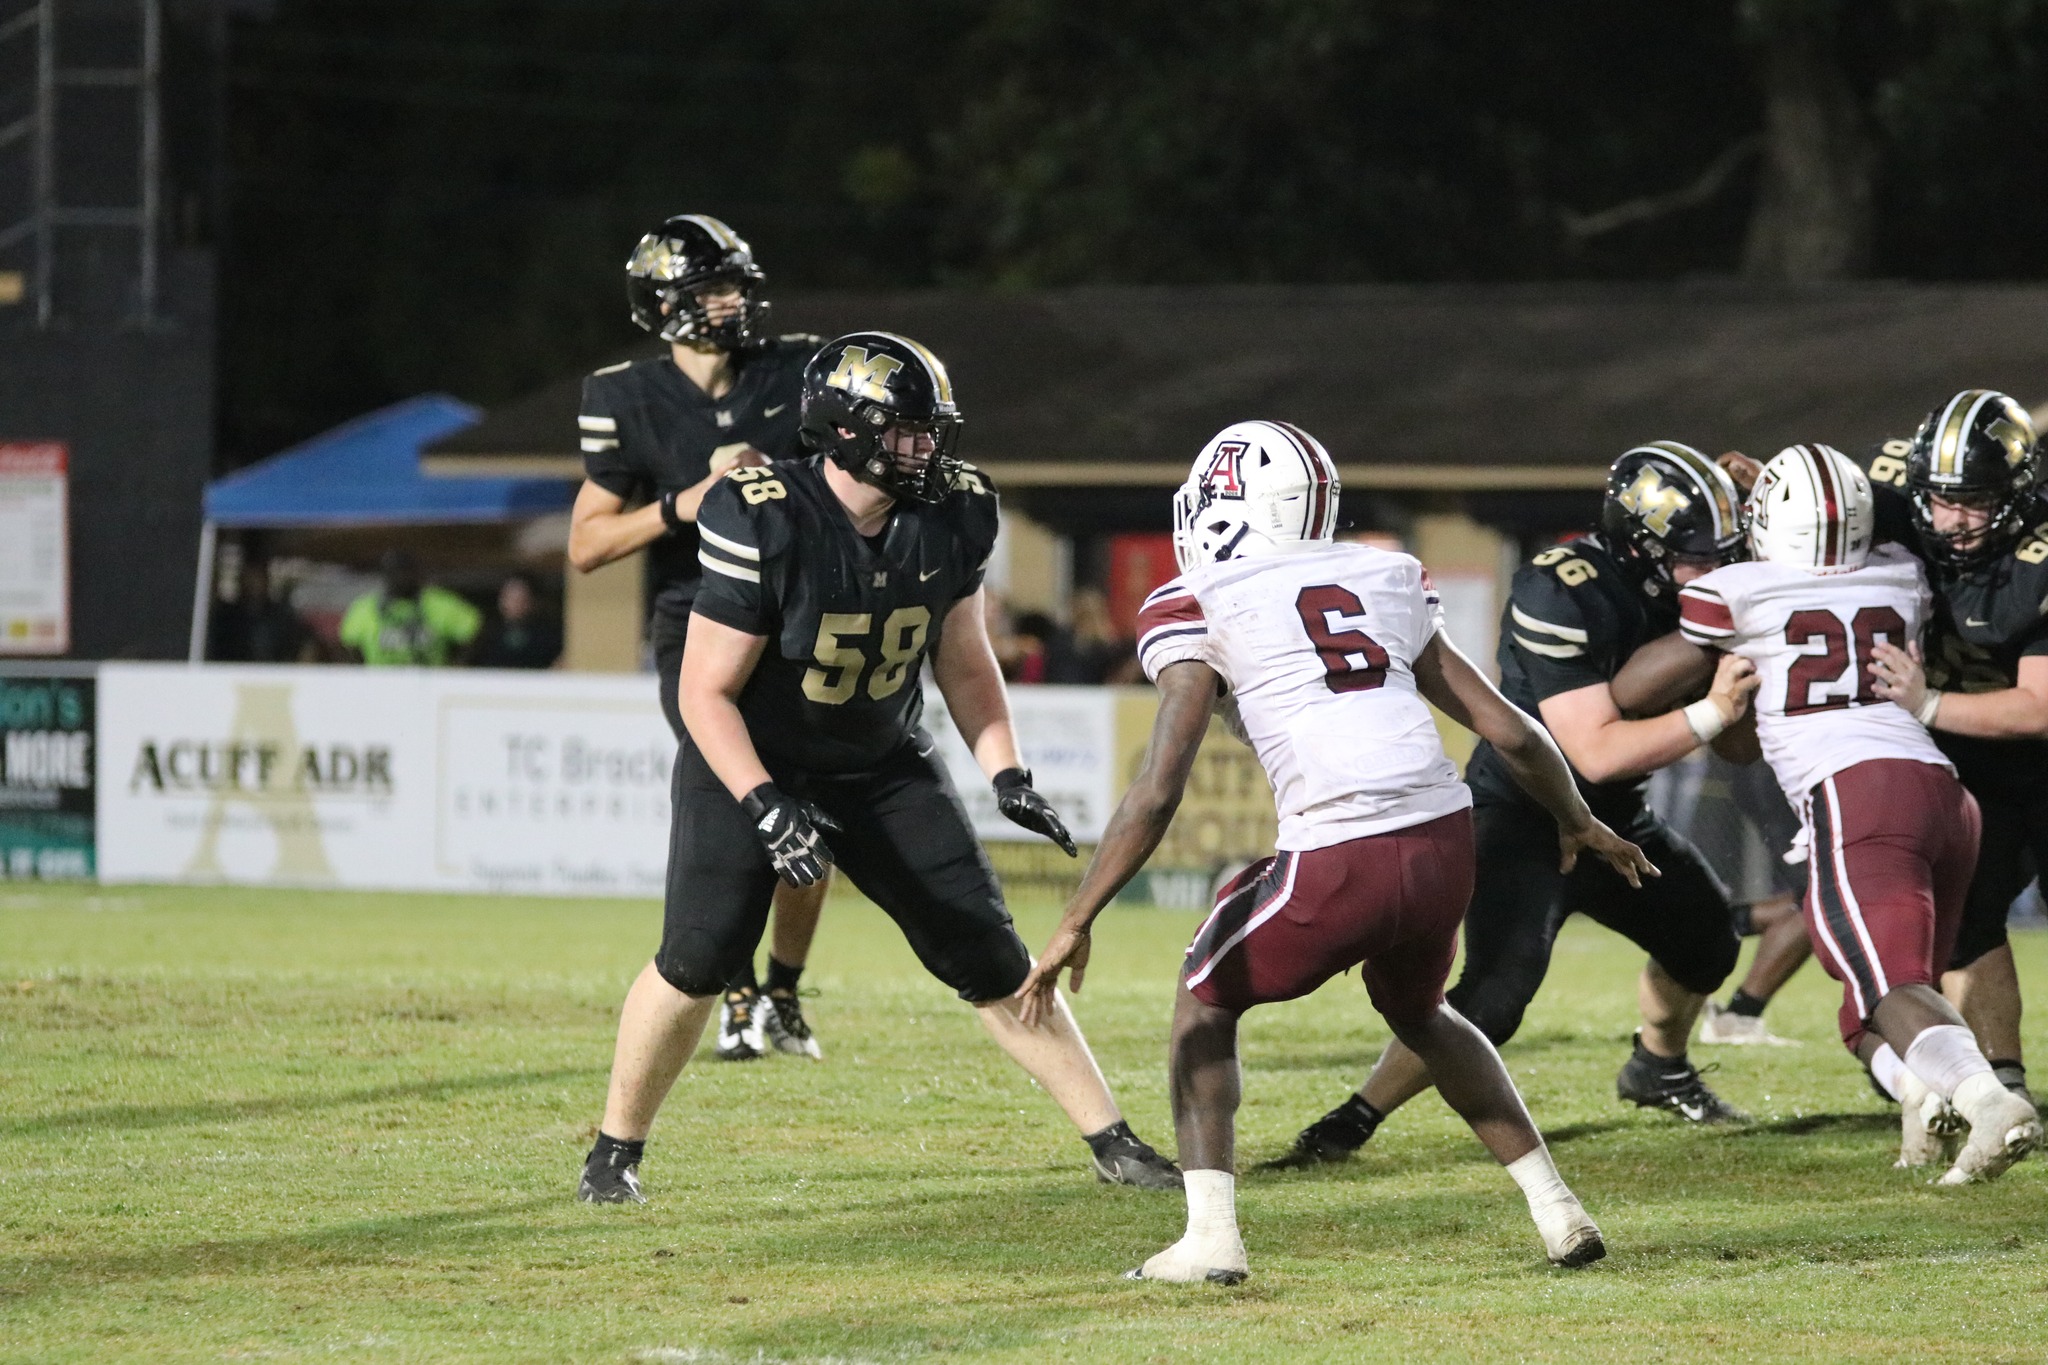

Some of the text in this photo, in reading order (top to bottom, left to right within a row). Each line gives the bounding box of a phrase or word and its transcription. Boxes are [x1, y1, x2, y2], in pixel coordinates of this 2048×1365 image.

[826, 345, 904, 402] M
[724, 466, 788, 505] 58
[1202, 440, 1251, 501] A
[1618, 463, 1692, 538] M
[801, 604, 931, 705] 58
[1295, 583, 1391, 695] 6
[6, 730, 90, 788] MORE
[130, 738, 394, 794] ACUFF ADR
